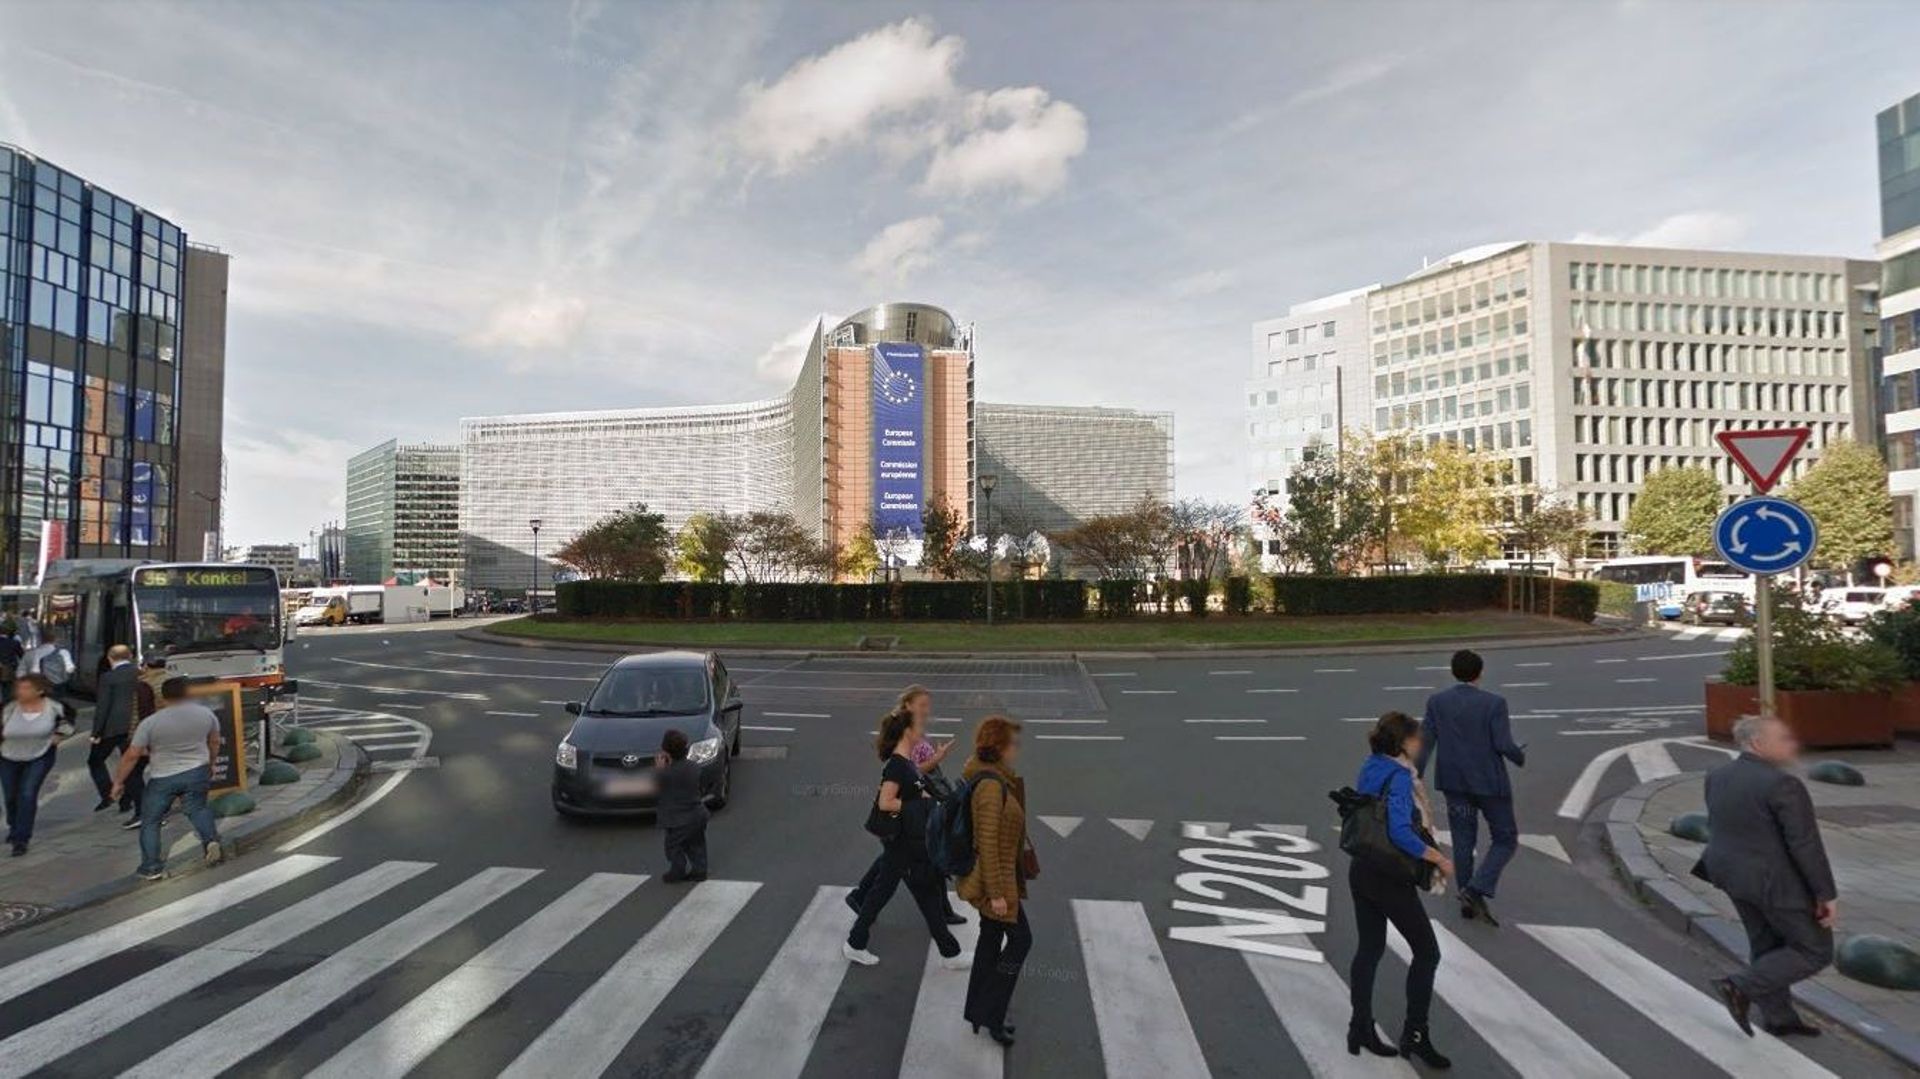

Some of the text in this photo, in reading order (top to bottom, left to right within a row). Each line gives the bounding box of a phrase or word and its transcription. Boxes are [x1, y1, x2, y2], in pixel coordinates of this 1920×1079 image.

[880, 460, 918, 469] Commission
[884, 491, 913, 501] European
[880, 502, 918, 511] Commission
[1168, 822, 1331, 963] N205
